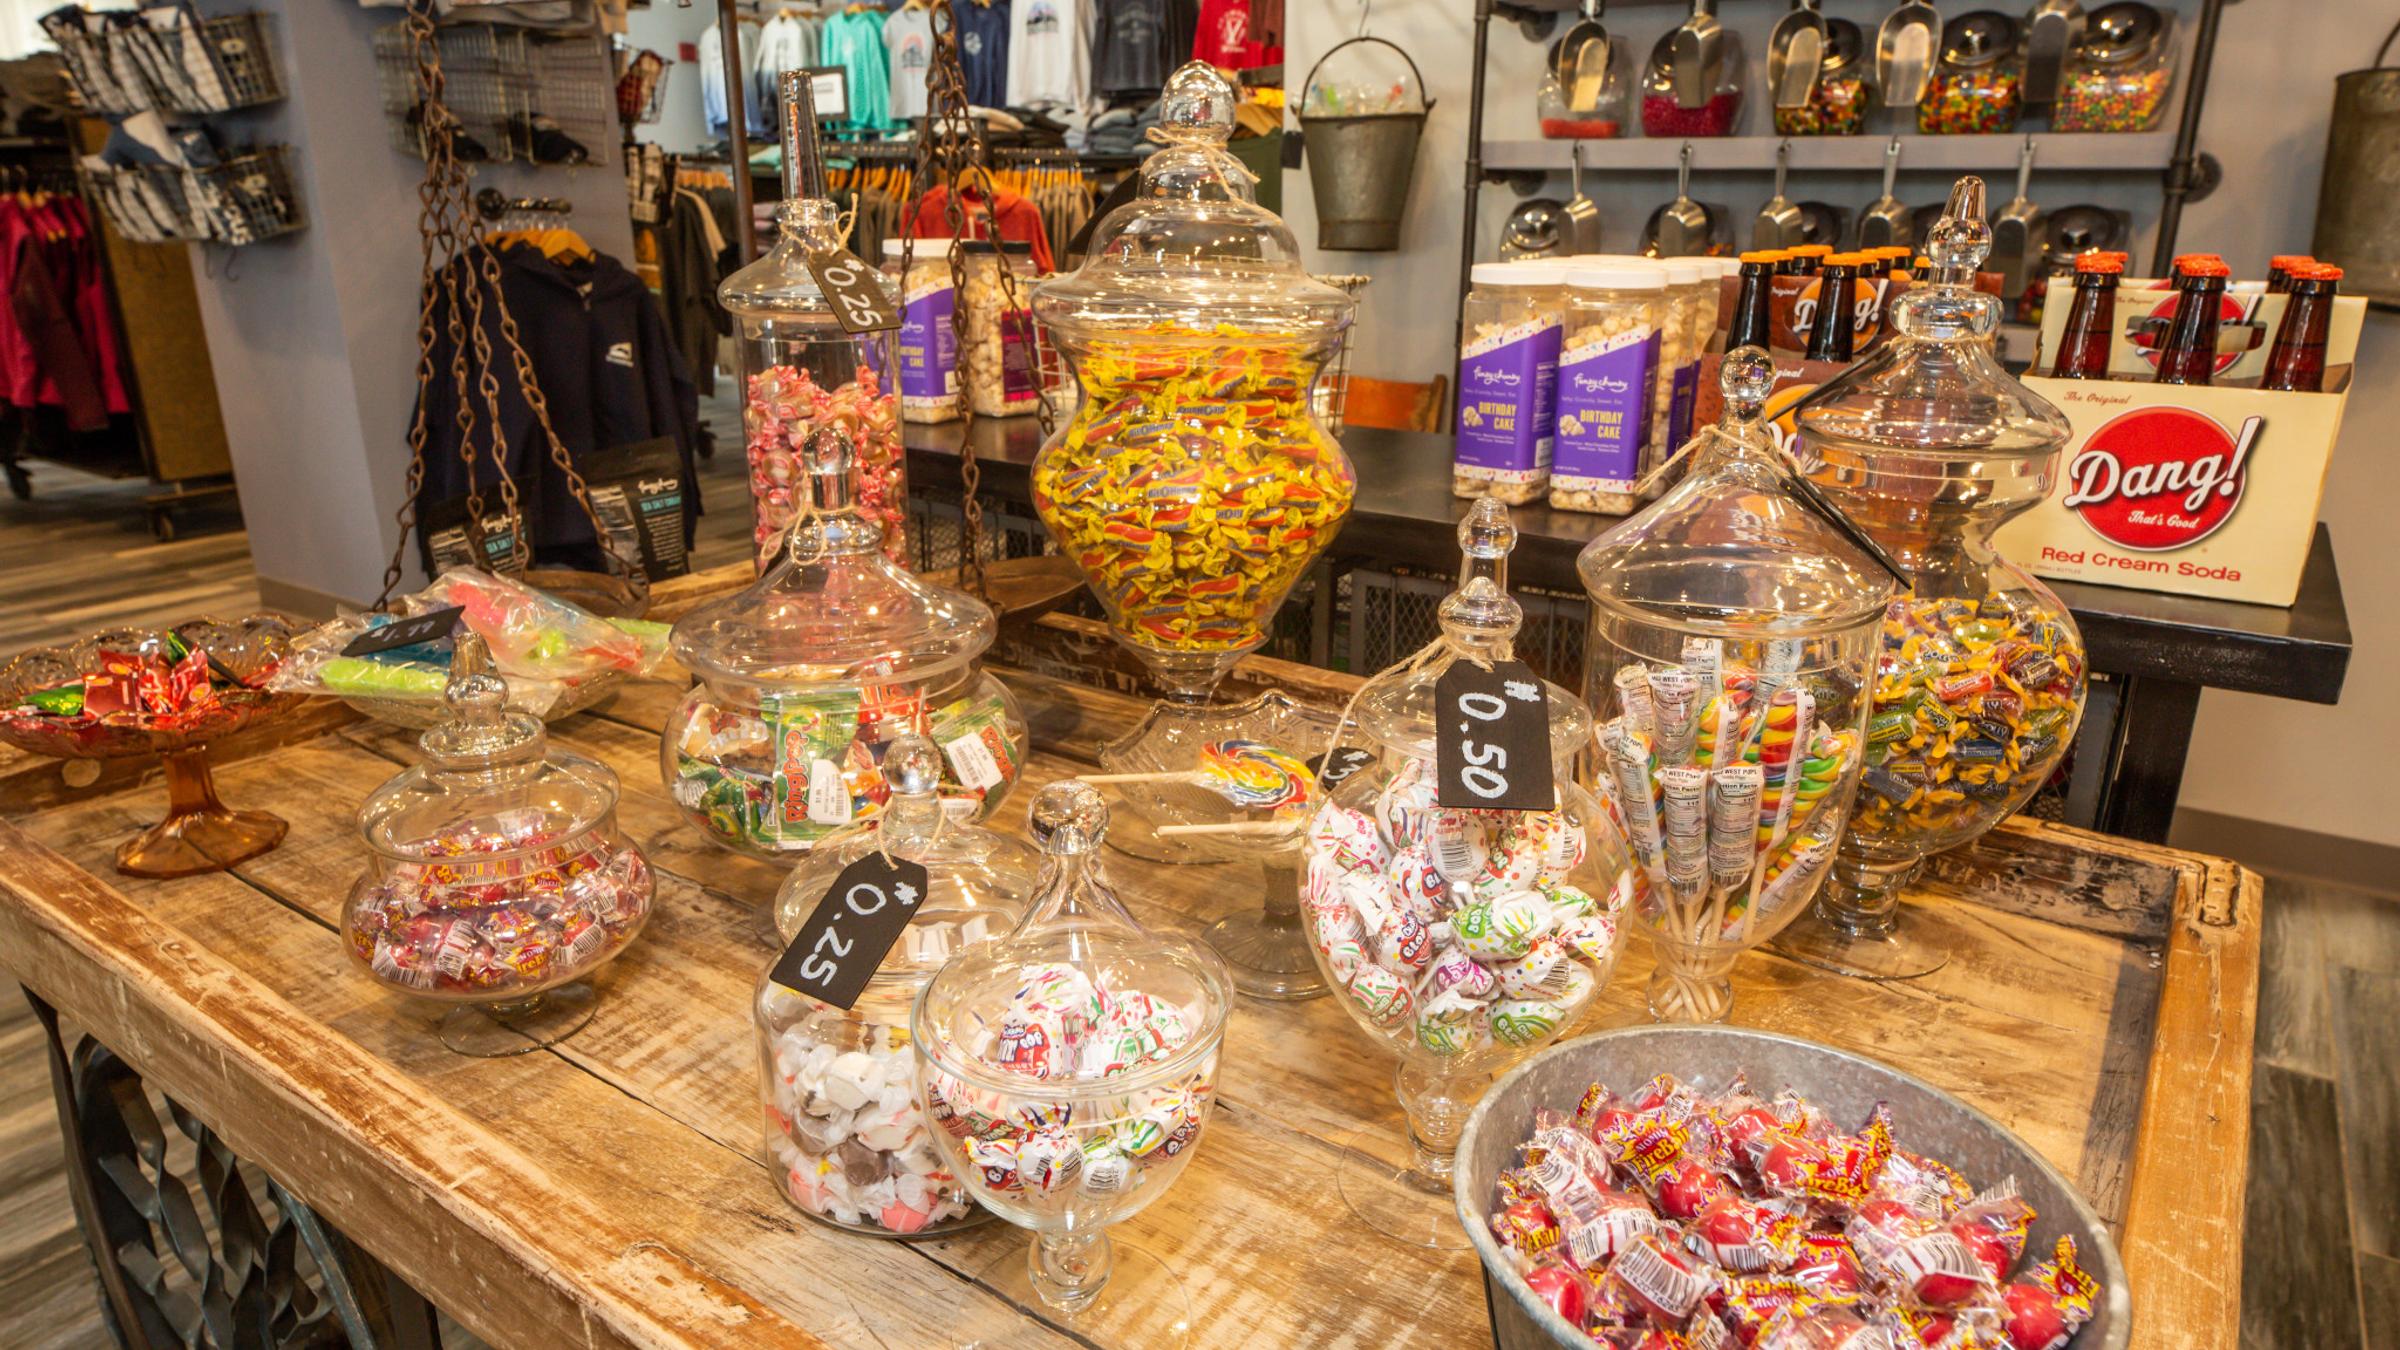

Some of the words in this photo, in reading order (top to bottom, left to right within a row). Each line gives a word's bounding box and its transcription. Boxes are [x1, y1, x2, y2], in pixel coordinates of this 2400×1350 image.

[1793, 279, 1889, 333] Dg!
[2064, 391, 2083, 401] The
[2087, 393, 2132, 407] Original
[1479, 401, 1517, 416] BIRTHDAY
[1493, 417, 1516, 432] CAKE
[1580, 409, 1624, 425] BIRTHDAY
[1597, 425, 1622, 440] CAKE
[2063, 415, 2262, 512] Dang!
[2128, 510, 2164, 527] That's
[2167, 514, 2200, 530] Good
[2041, 547, 2085, 565] Red
[2092, 551, 2170, 575] Cream
[2177, 561, 2242, 583] Soda
